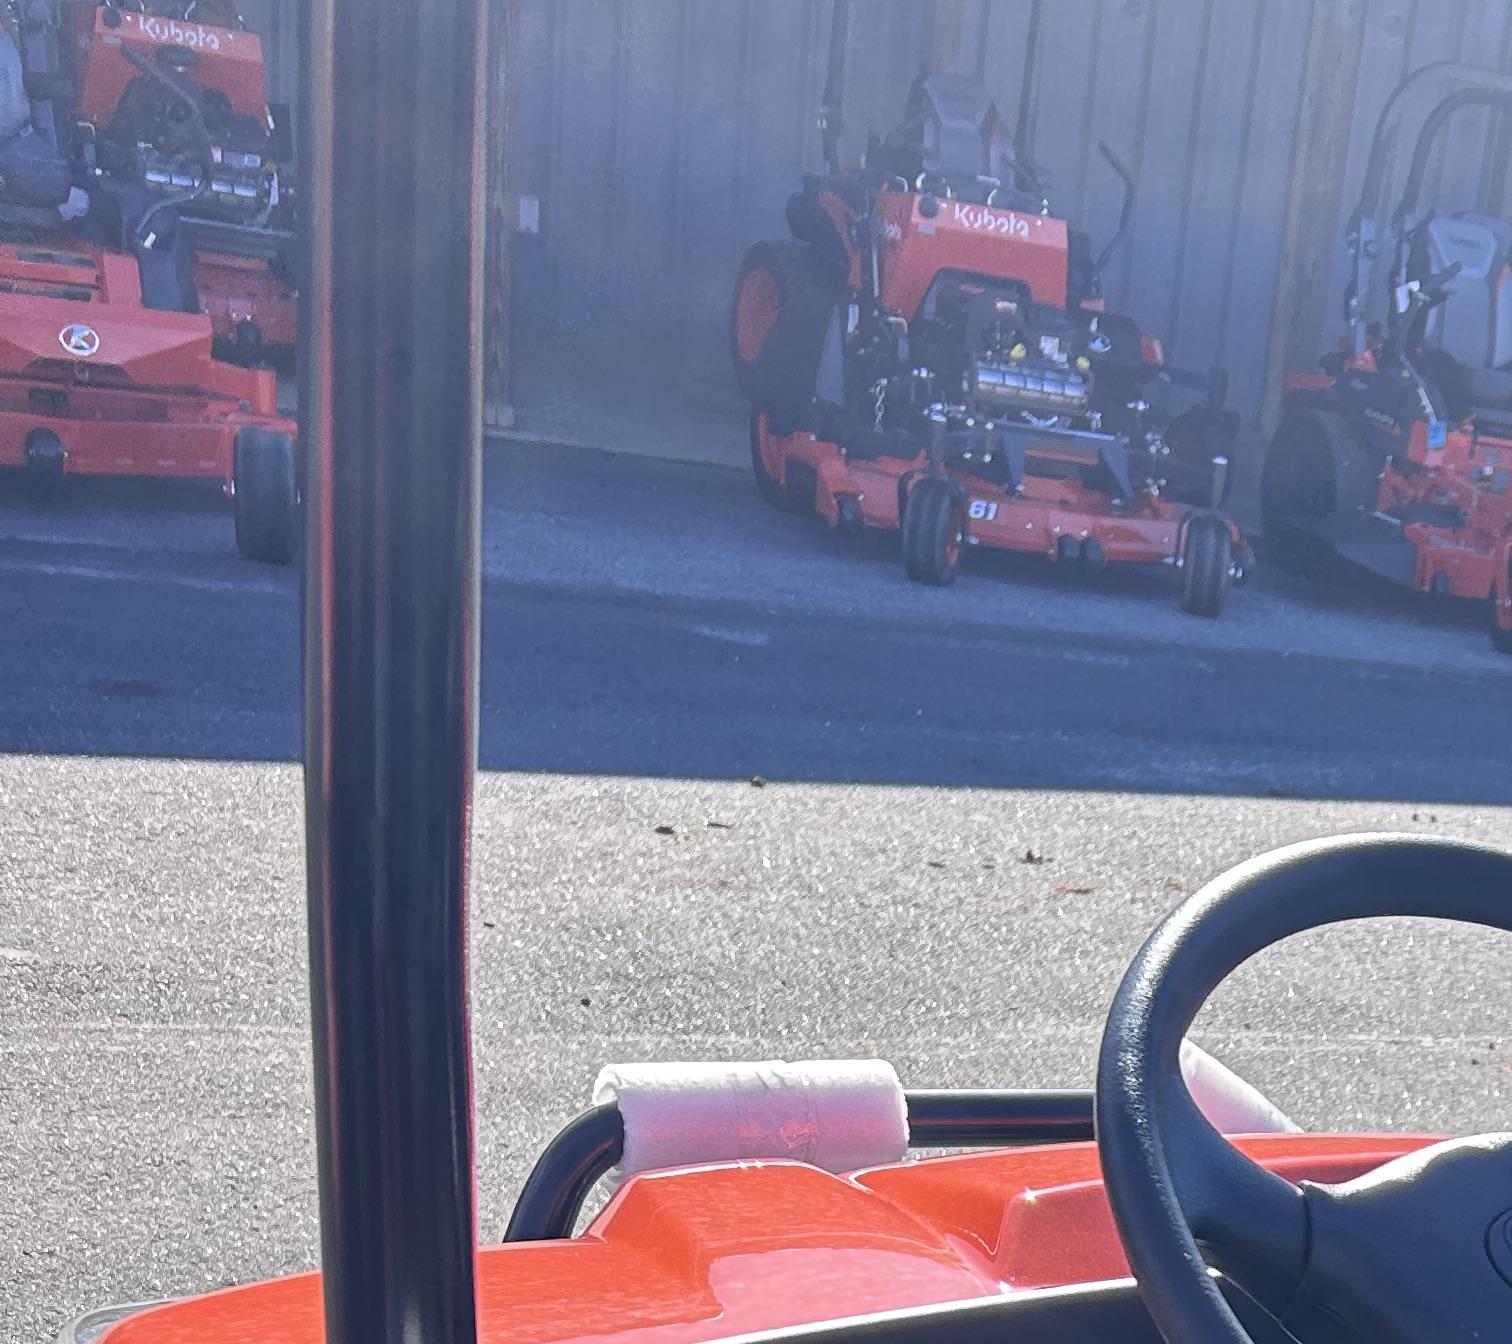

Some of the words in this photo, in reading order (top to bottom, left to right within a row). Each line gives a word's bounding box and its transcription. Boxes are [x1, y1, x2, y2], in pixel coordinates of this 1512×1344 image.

[138, 15, 220, 50] Kubota
[954, 202, 1030, 237] Kubota
[968, 500, 998, 520] 81
